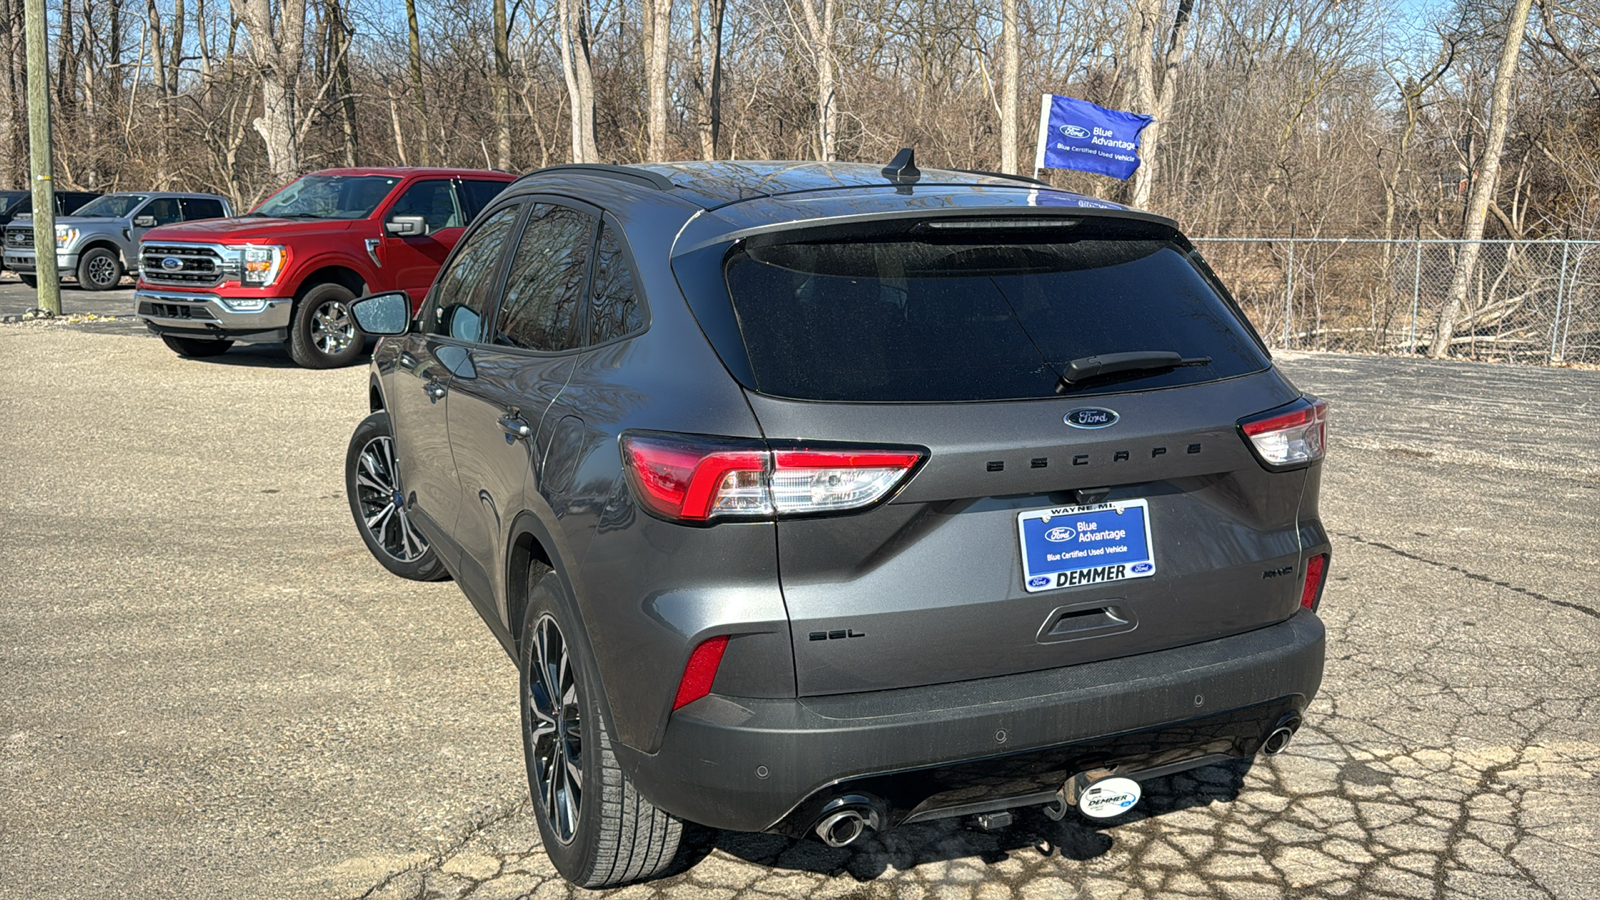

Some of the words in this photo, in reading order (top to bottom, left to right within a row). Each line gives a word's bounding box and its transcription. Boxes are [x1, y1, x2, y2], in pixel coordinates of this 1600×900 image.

[1063, 125, 1086, 137] Ford
[1093, 127, 1113, 138] Blue
[1091, 136, 1136, 151] Advantage
[1057, 142, 1070, 151] Blue
[1071, 146, 1097, 155] Certified
[1098, 150, 1113, 159] Used
[1078, 410, 1108, 424] Ford
[986, 443, 1202, 472] ESCAPE
[1077, 521, 1097, 532] Blue
[1050, 528, 1071, 541] Ford
[1079, 529, 1126, 543] Advantage
[1046, 553, 1061, 562] Blue
[1061, 549, 1088, 559] Certified
[1088, 547, 1104, 556] Used
[1105, 545, 1128, 554] Vehicle
[1133, 563, 1151, 573] Ford
[1030, 577, 1049, 587] Ford
[1056, 564, 1126, 587] DEMMER
[809, 628, 865, 641] SEL
[1088, 794, 1128, 806] DEMMER
